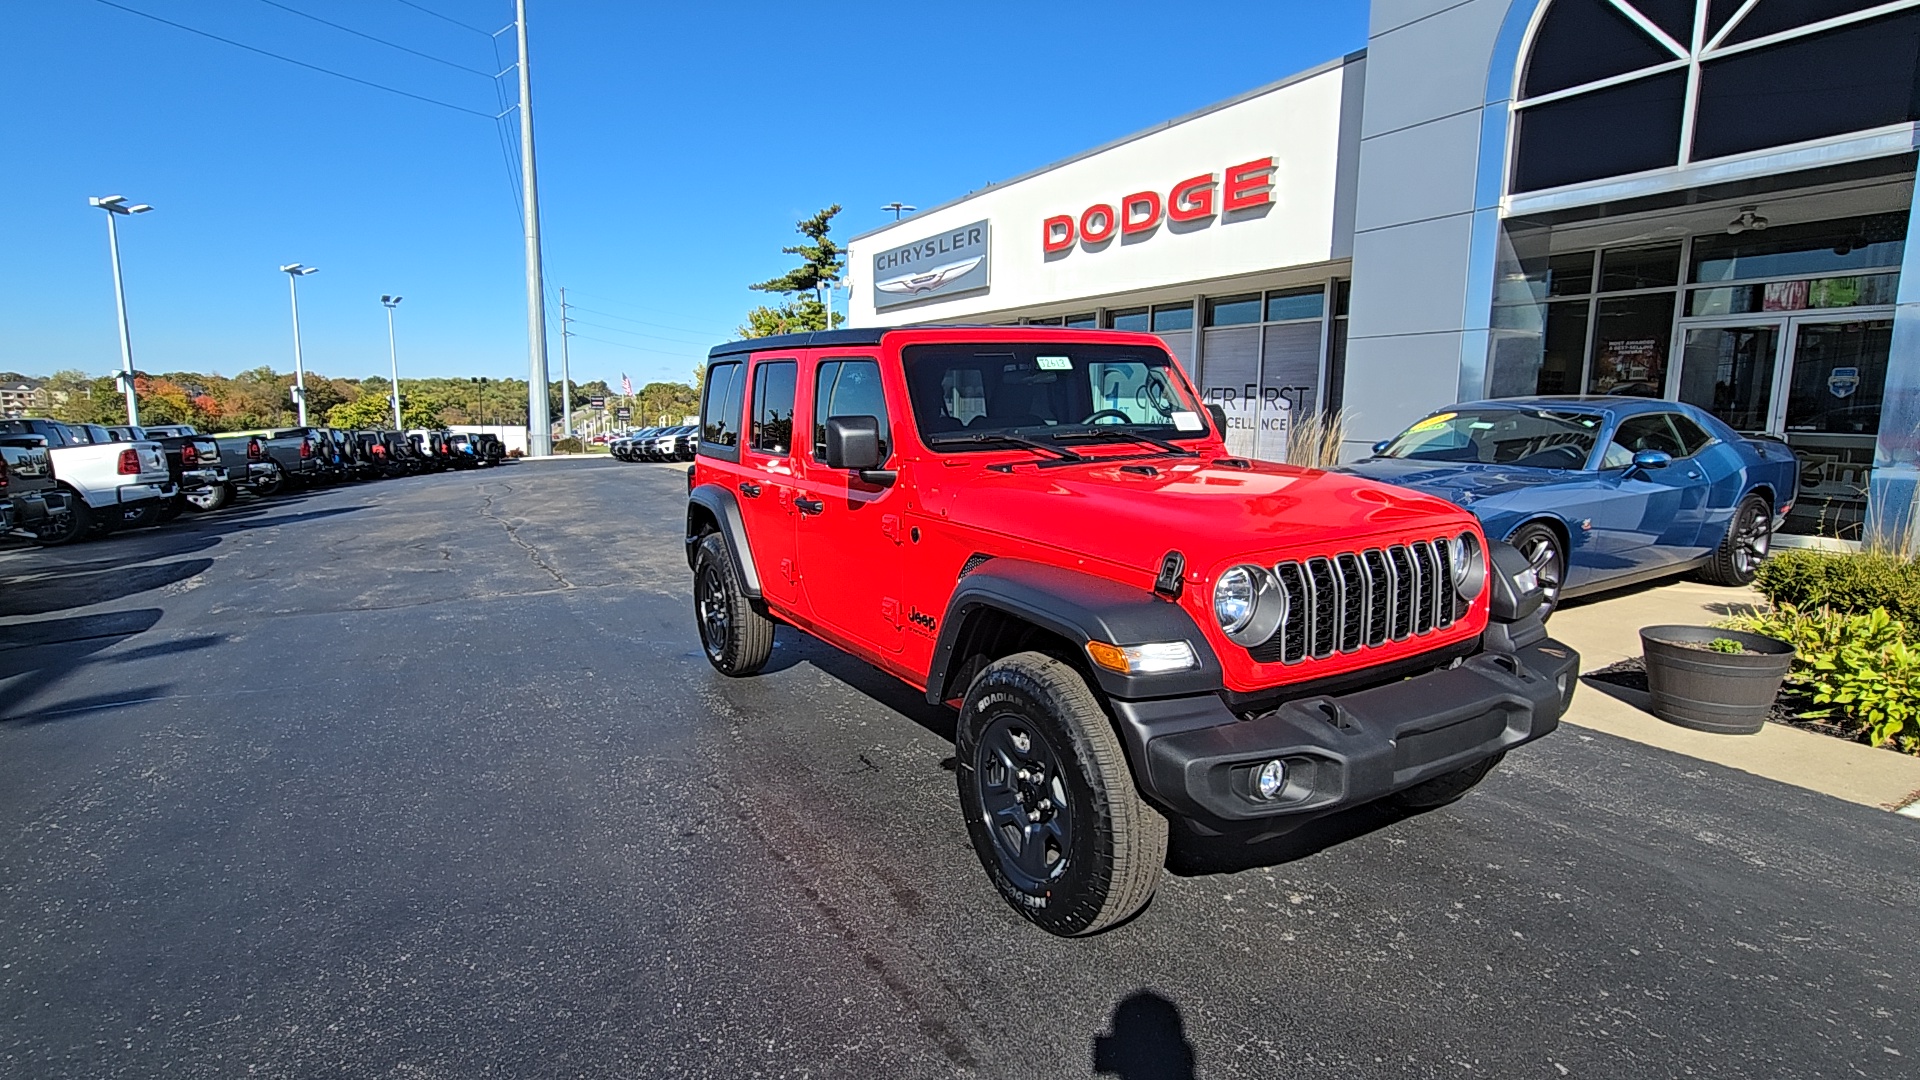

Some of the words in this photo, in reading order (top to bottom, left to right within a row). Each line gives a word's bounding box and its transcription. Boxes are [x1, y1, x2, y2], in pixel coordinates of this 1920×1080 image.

[1043, 156, 1279, 253] DODGE
[876, 227, 982, 271] CHRYSLER
[1244, 383, 1310, 412] FIRST
[908, 605, 936, 632] Jeep
[978, 692, 1023, 713] ROADIAN
